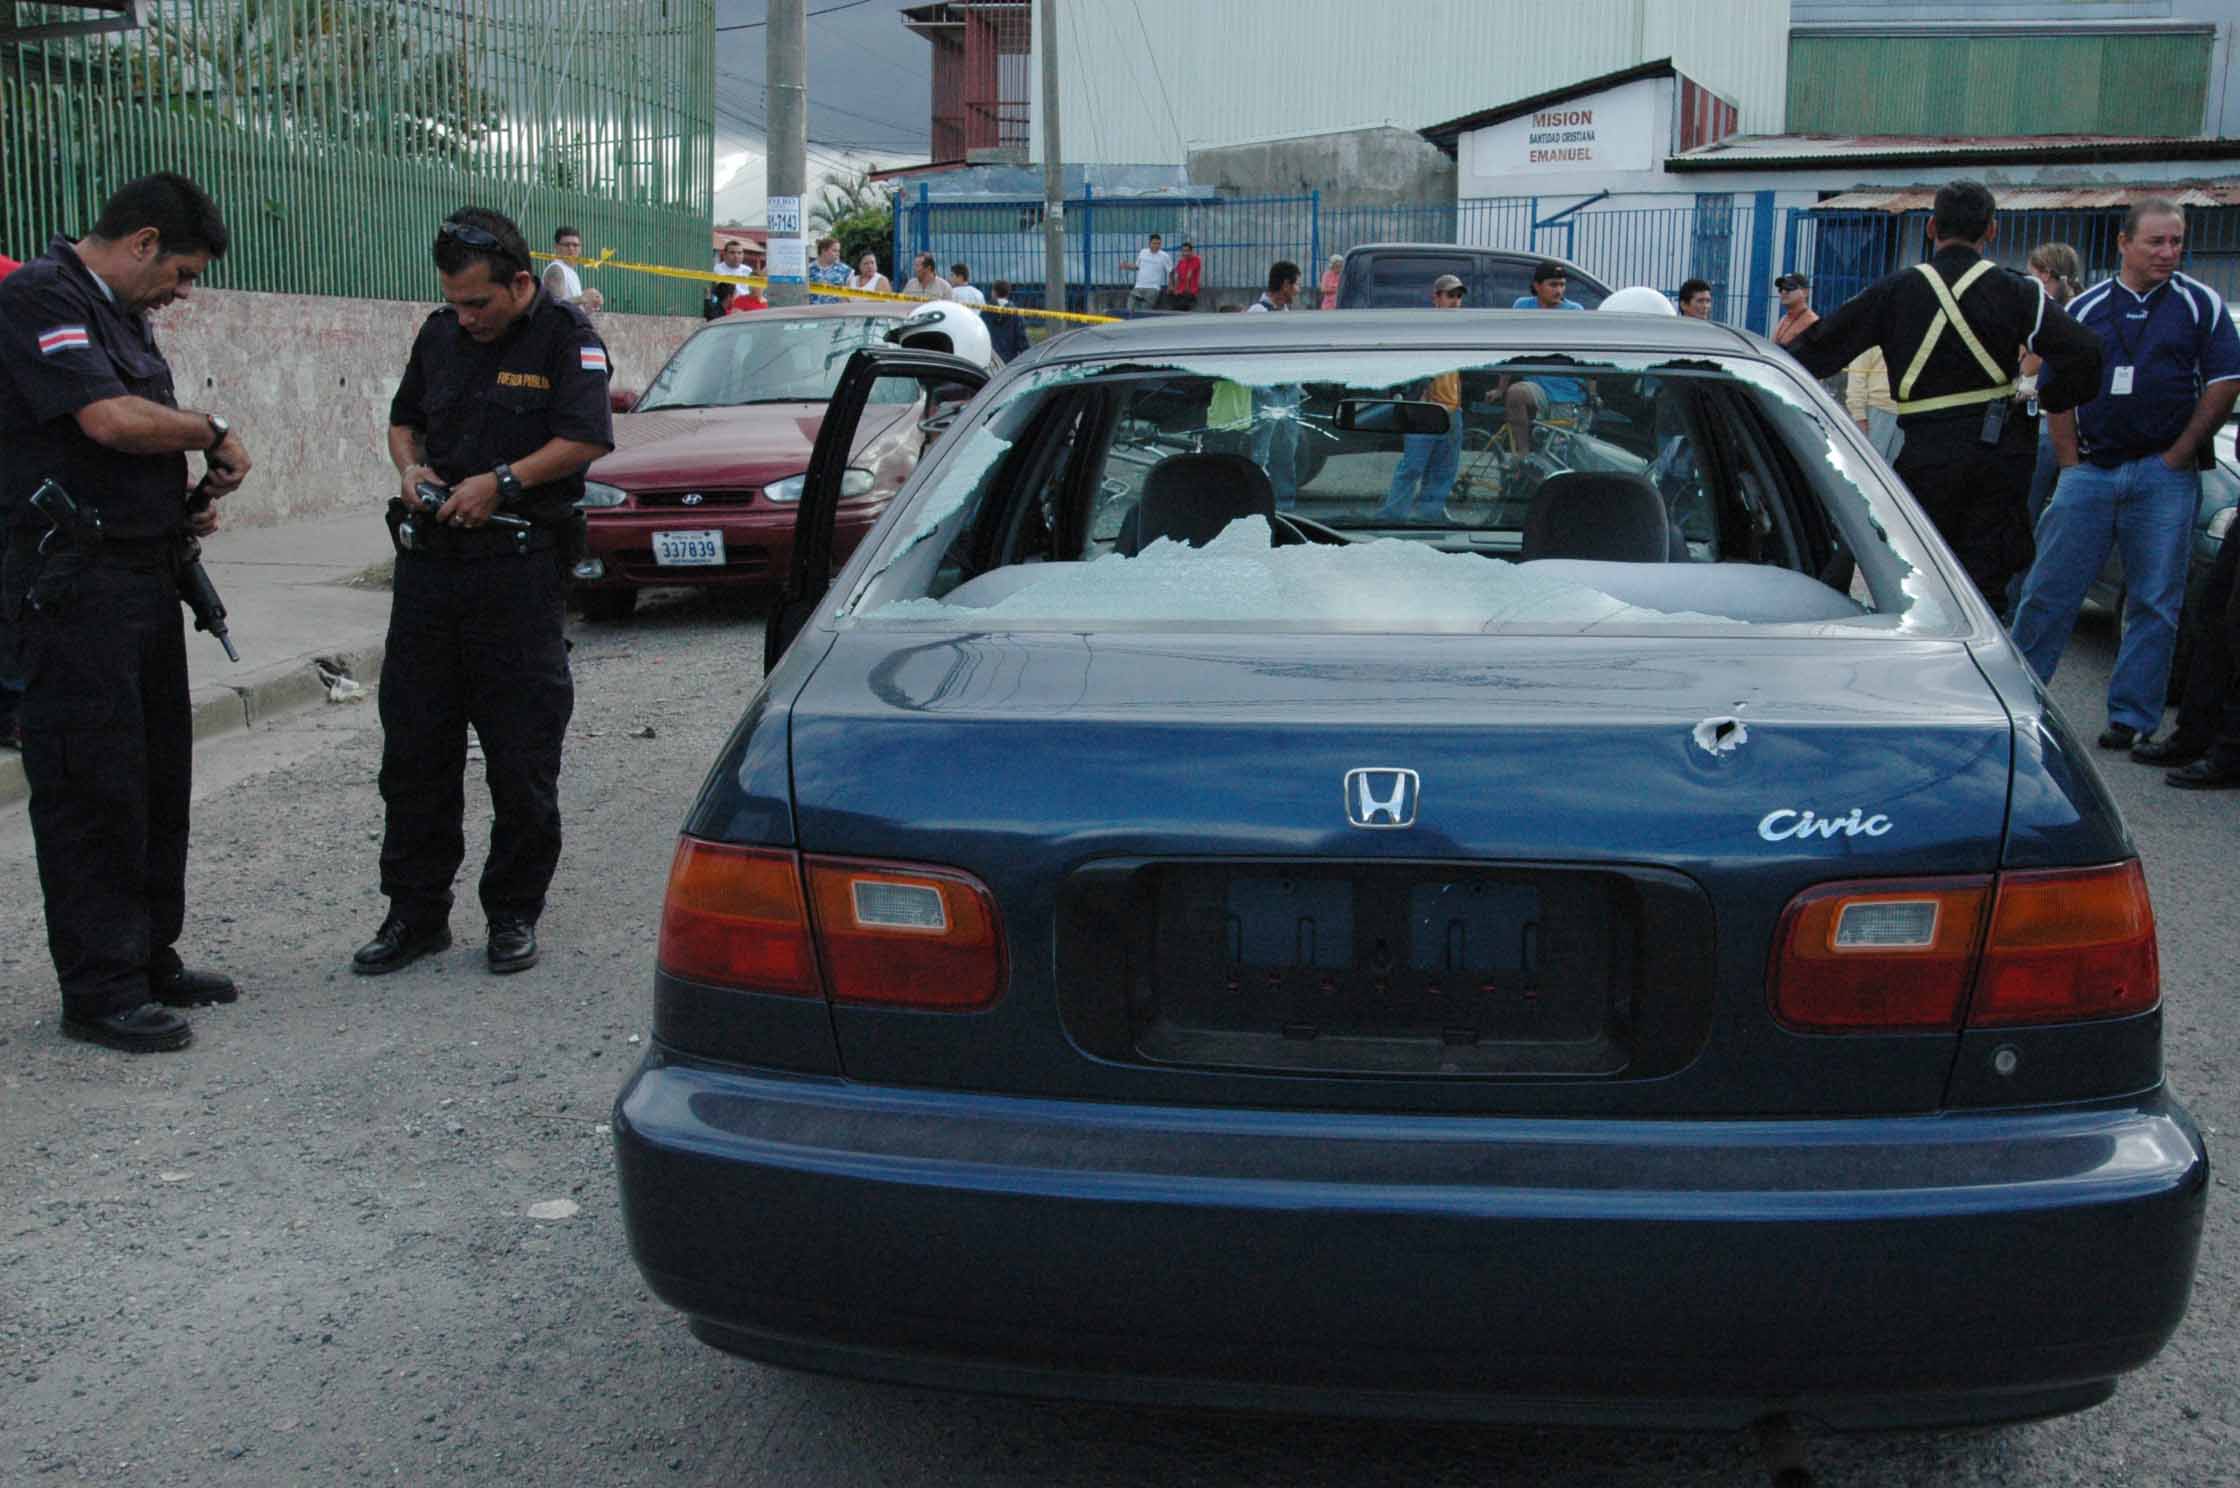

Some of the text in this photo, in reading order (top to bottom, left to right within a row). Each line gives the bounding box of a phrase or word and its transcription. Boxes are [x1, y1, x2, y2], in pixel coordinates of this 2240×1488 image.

[1532, 111, 1592, 127] MISION
[1530, 147, 1592, 163] EMANUEL
[661, 541, 716, 558] 337839
[1758, 808, 1893, 841] Civic
